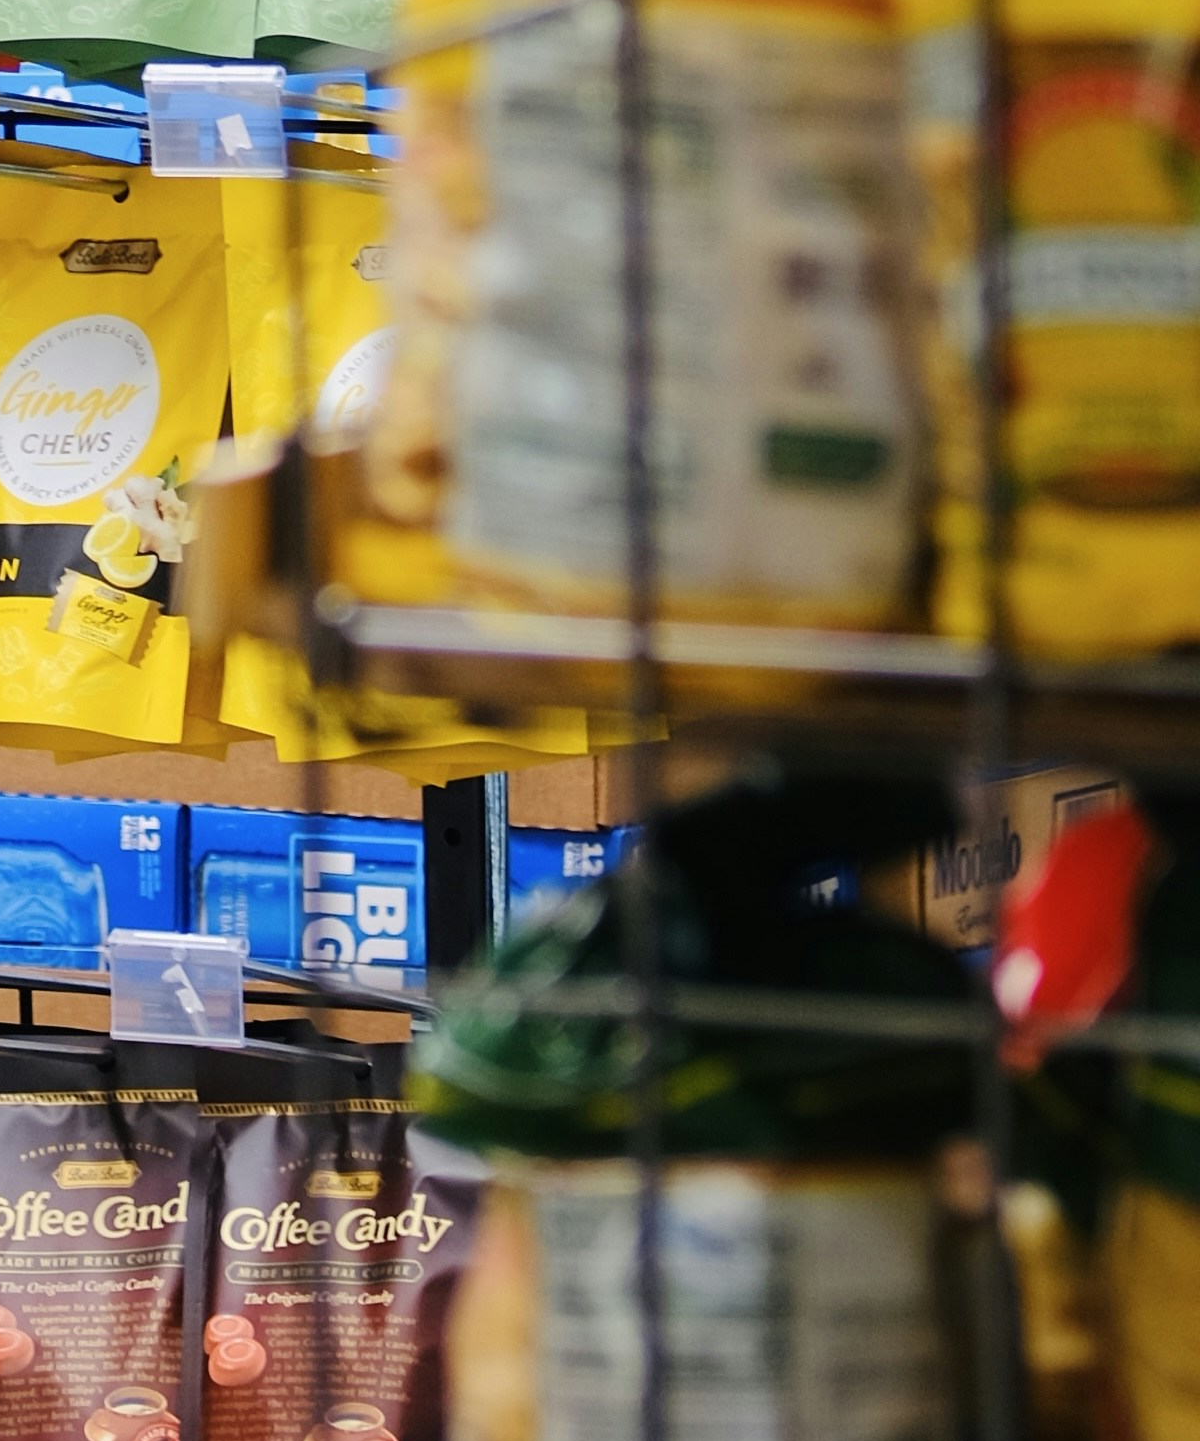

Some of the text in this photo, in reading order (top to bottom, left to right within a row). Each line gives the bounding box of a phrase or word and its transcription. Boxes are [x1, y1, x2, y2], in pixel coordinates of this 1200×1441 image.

[19, 324, 122, 370] MADE WITH REAL
[338, 350, 370, 386] MADE
[0, 369, 150, 436] Ginger
[20, 432, 113, 455] CHEWS
[21, 482, 51, 500] SPICY
[102, 435, 139, 476] CANDY
[138, 815, 162, 852] 12
[583, 842, 605, 878] 12
[302, 851, 357, 983] LIG
[356, 885, 409, 987] BU
[20, 1142, 88, 1162] PREMIUM
[93, 1180, 191, 1240] Cand
[220, 1193, 453, 1254] Coffee Candy
[39, 1255, 79, 1268] WITH
[83, 1253, 121, 1266] REAL
[126, 1250, 181, 1266] COFFEE
[237, 1266, 278, 1280] MADE
[361, 1266, 411, 1279] COFFEE
[0, 1275, 165, 1297] The Original Coffee Candy
[244, 1292, 267, 1306] The
[267, 1291, 315, 1307] Original
[357, 1290, 395, 1307] Candy
